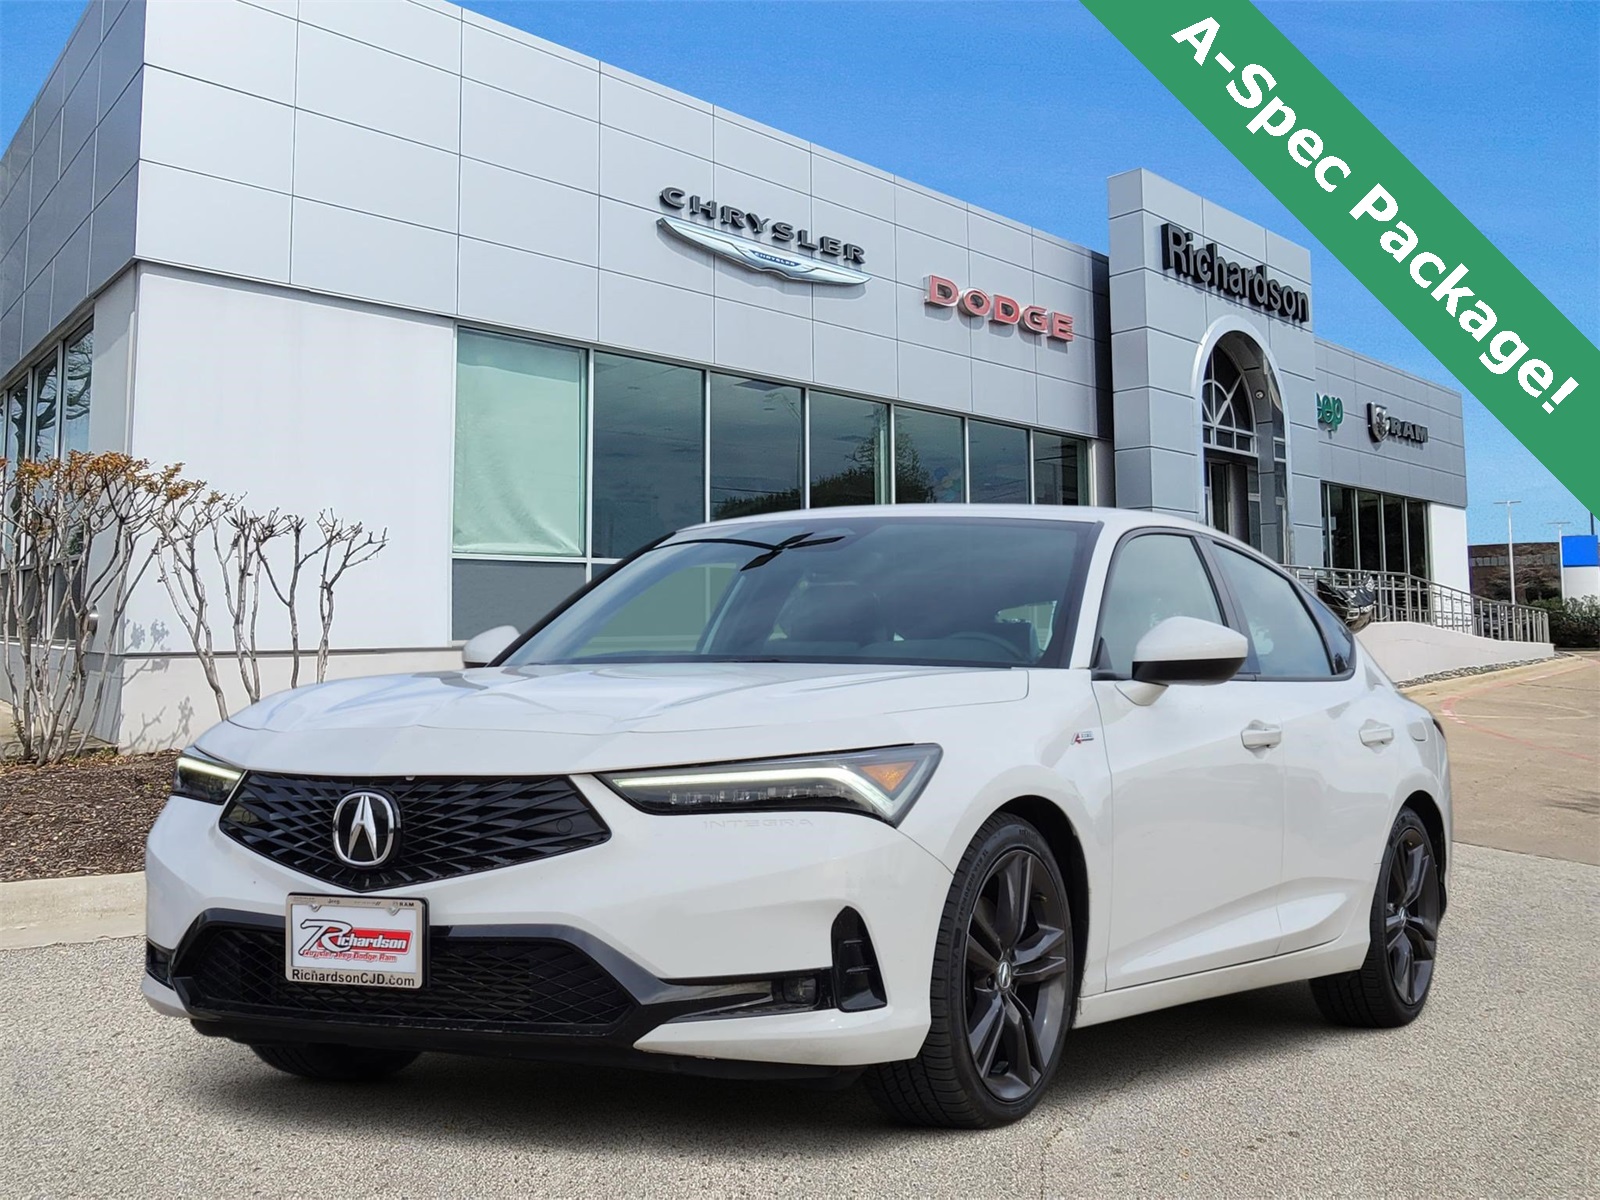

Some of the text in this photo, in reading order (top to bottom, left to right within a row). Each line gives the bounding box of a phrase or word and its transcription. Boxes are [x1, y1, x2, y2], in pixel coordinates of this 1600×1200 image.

[659, 187, 866, 264] CHRYSLER
[1161, 223, 1309, 323] Richardson
[923, 275, 1074, 342] DODGE
[1316, 392, 1343, 432] eep
[1387, 416, 1428, 443] RAM
[703, 818, 814, 831] INTEGRA
[298, 919, 407, 956] Richardson
[292, 969, 415, 987] RichardsonCJD.com
